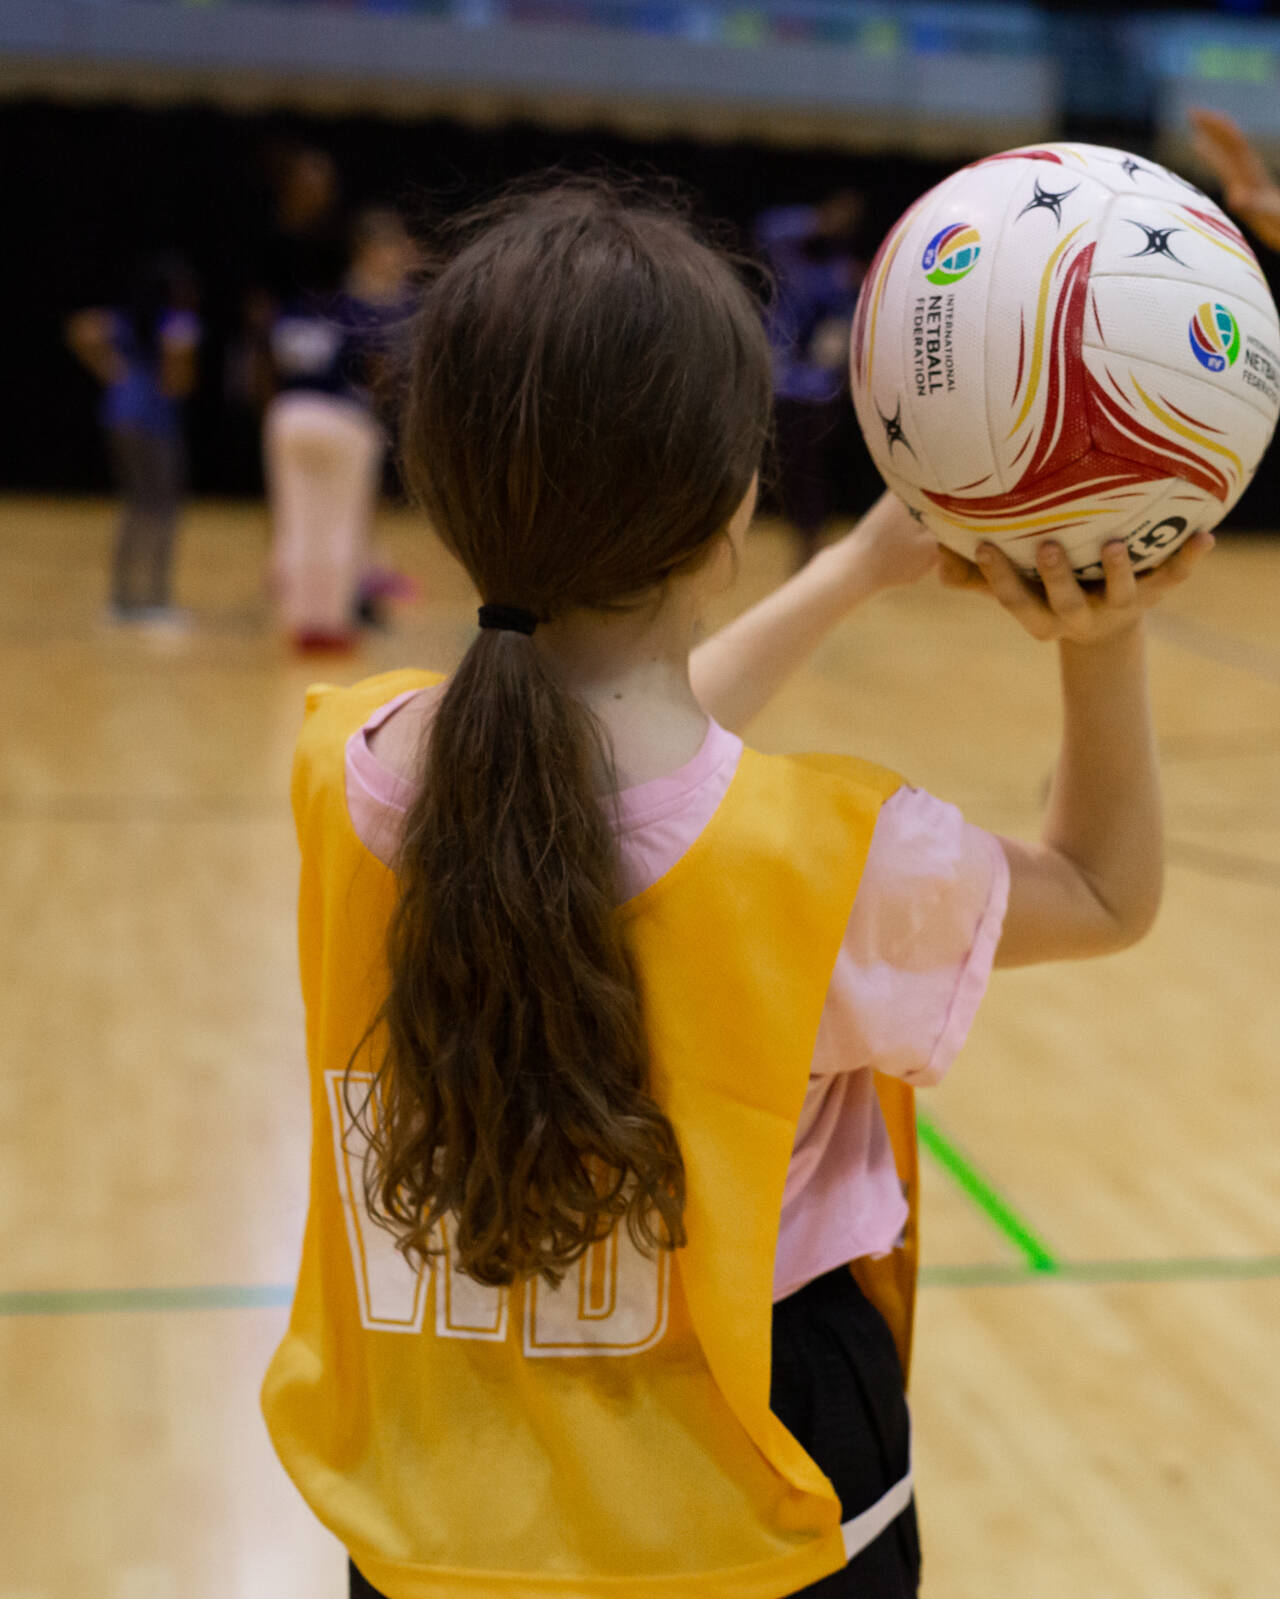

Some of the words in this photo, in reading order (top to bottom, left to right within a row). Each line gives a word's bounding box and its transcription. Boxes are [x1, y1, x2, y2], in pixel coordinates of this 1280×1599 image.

[913, 297, 926, 396] FEDERATION
[926, 295, 943, 395] NETBALL
[944, 294, 955, 393] INTERNATIONAL
